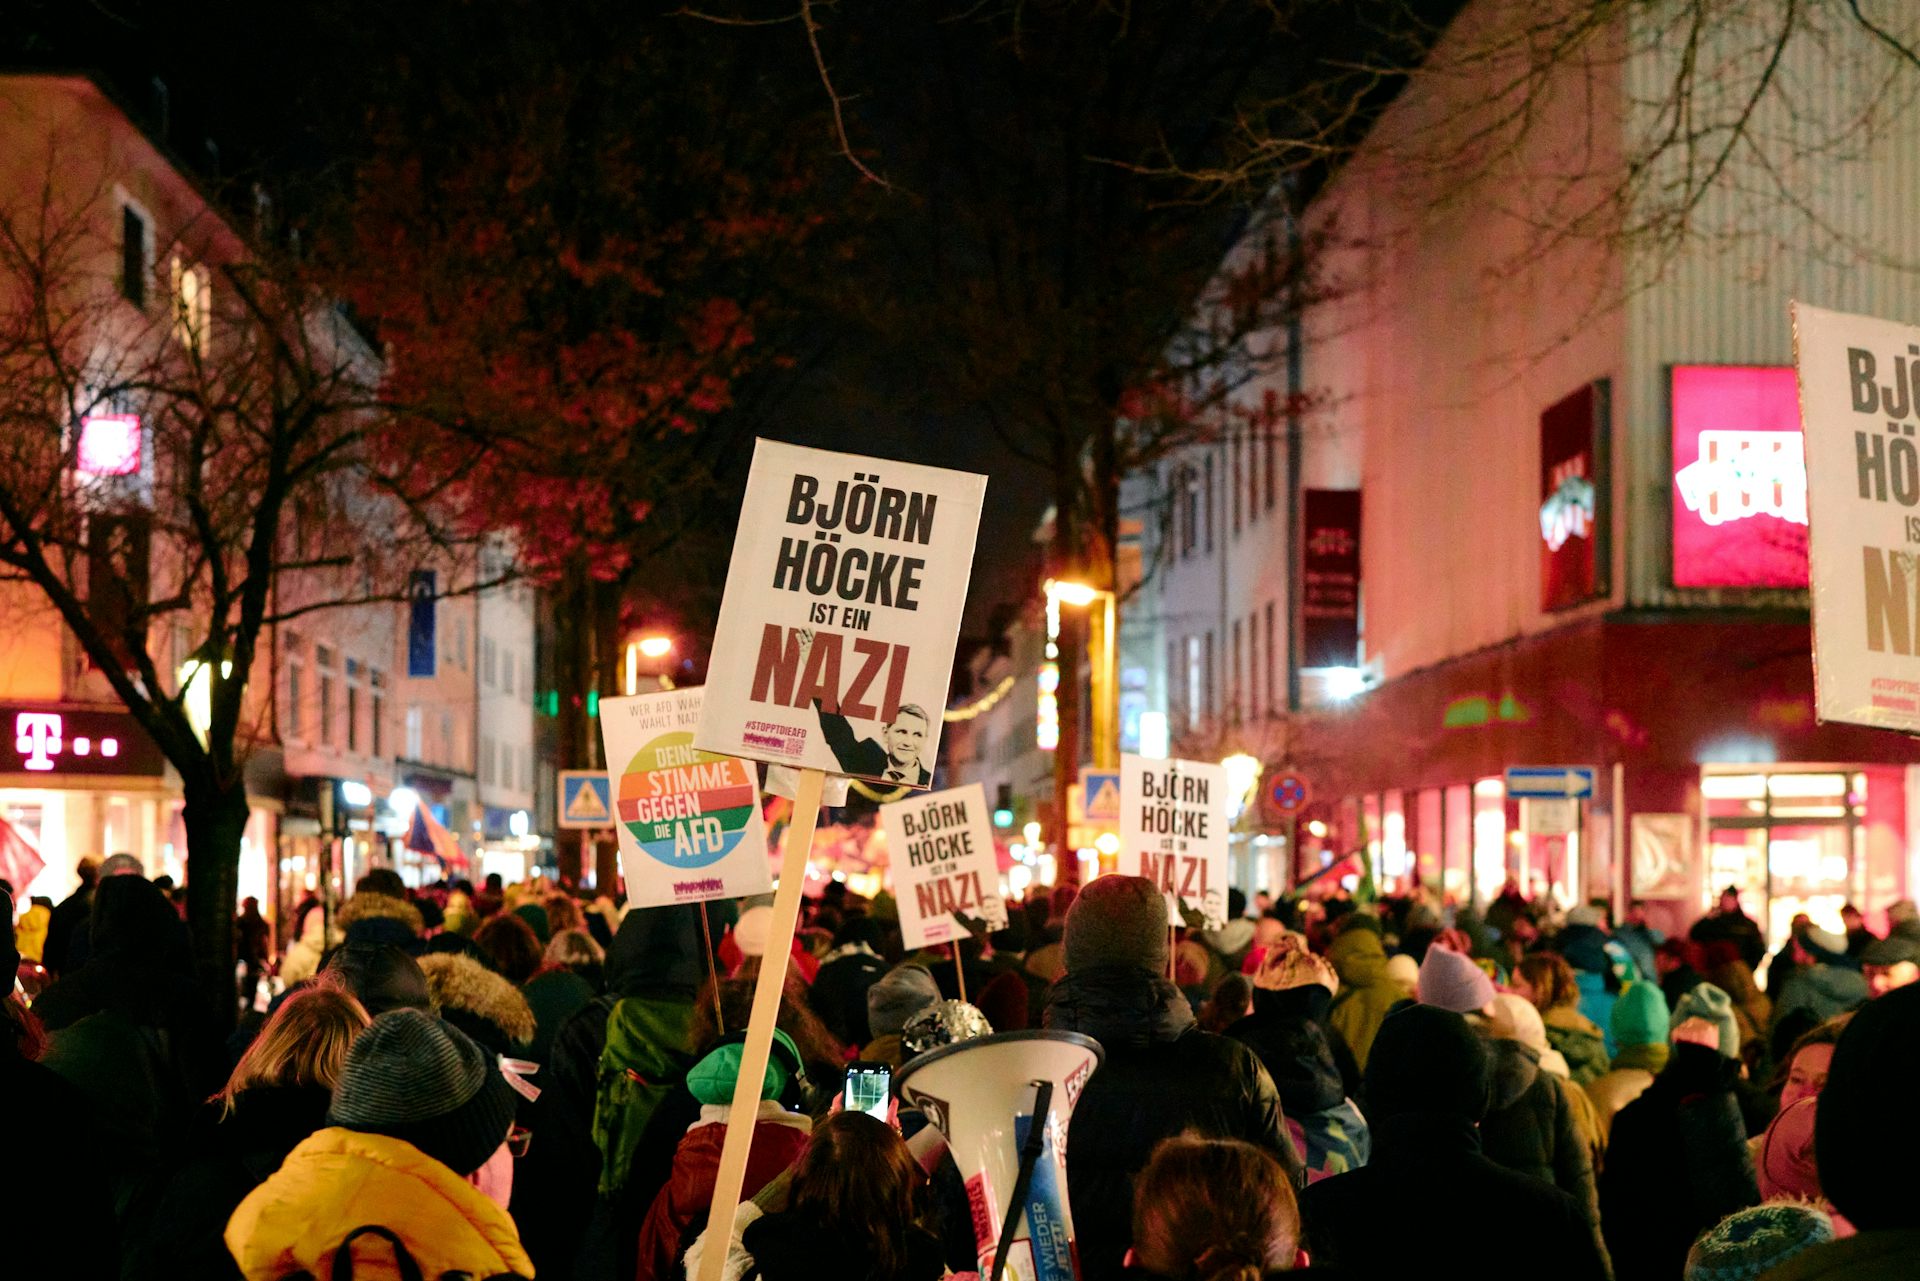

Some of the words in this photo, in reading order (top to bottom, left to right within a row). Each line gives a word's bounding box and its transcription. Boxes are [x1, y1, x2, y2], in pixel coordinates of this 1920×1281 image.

[786, 472, 938, 546] BJÖRN
[773, 531, 926, 611] HÖCKE
[809, 602, 838, 626] IST
[841, 607, 871, 631] EIN
[1863, 545, 1920, 657] N
[750, 623, 911, 724] NAZI
[629, 703, 650, 717] WER
[745, 720, 807, 738] #STOPPTDIEAFD
[655, 743, 701, 769] DEINE
[647, 762, 732, 796] STIMME
[1142, 768, 1209, 805] BJÖRN
[637, 791, 700, 825] GEGEN
[902, 800, 968, 837] BJÖRN
[1141, 801, 1209, 839] HÖCKE
[655, 823, 672, 840] DIE
[674, 816, 724, 858] AFD
[908, 832, 974, 867] HÖCKE
[1140, 851, 1208, 900] NAZI
[915, 870, 983, 919] NAZI
[1032, 1202, 1056, 1270] WIEDER
